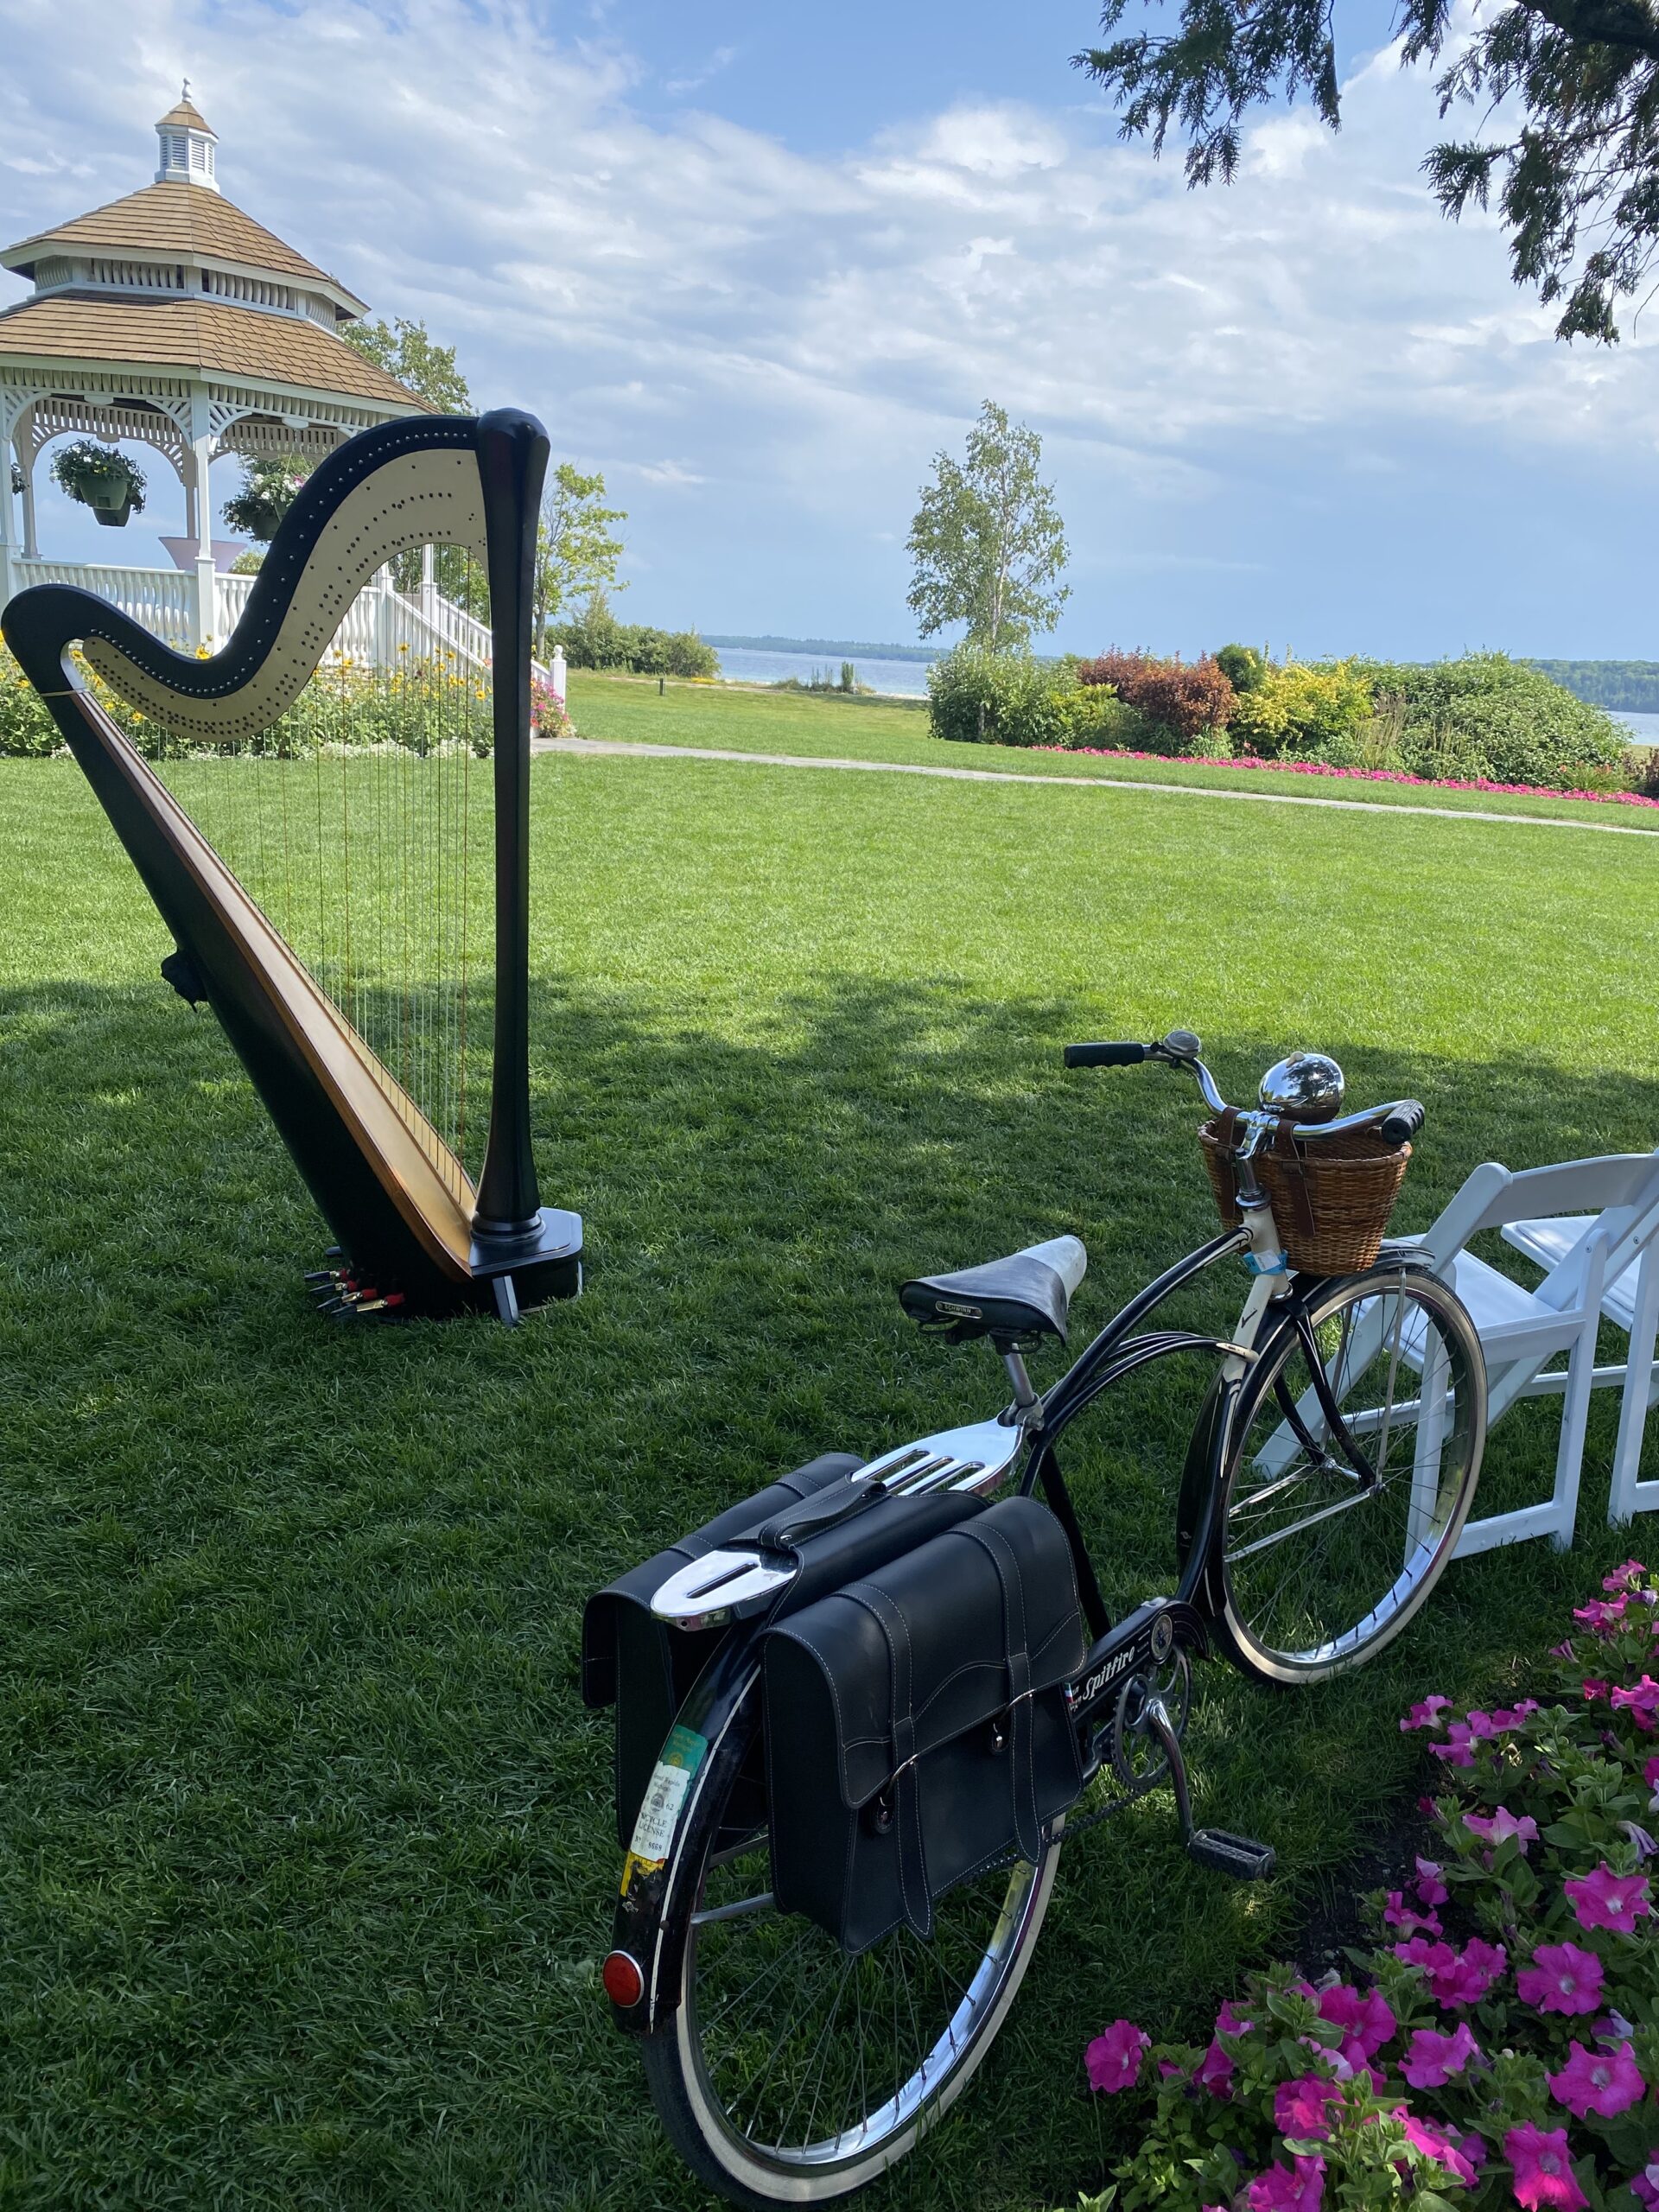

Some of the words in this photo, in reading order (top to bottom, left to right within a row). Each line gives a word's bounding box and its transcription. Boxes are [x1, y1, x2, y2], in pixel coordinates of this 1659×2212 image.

[944, 1303, 972, 1314] SCHWINN
[1082, 1645, 1135, 1701] Spitfire
[665, 1802, 675, 1811] 62
[638, 1821, 665, 1838] LICENSE
